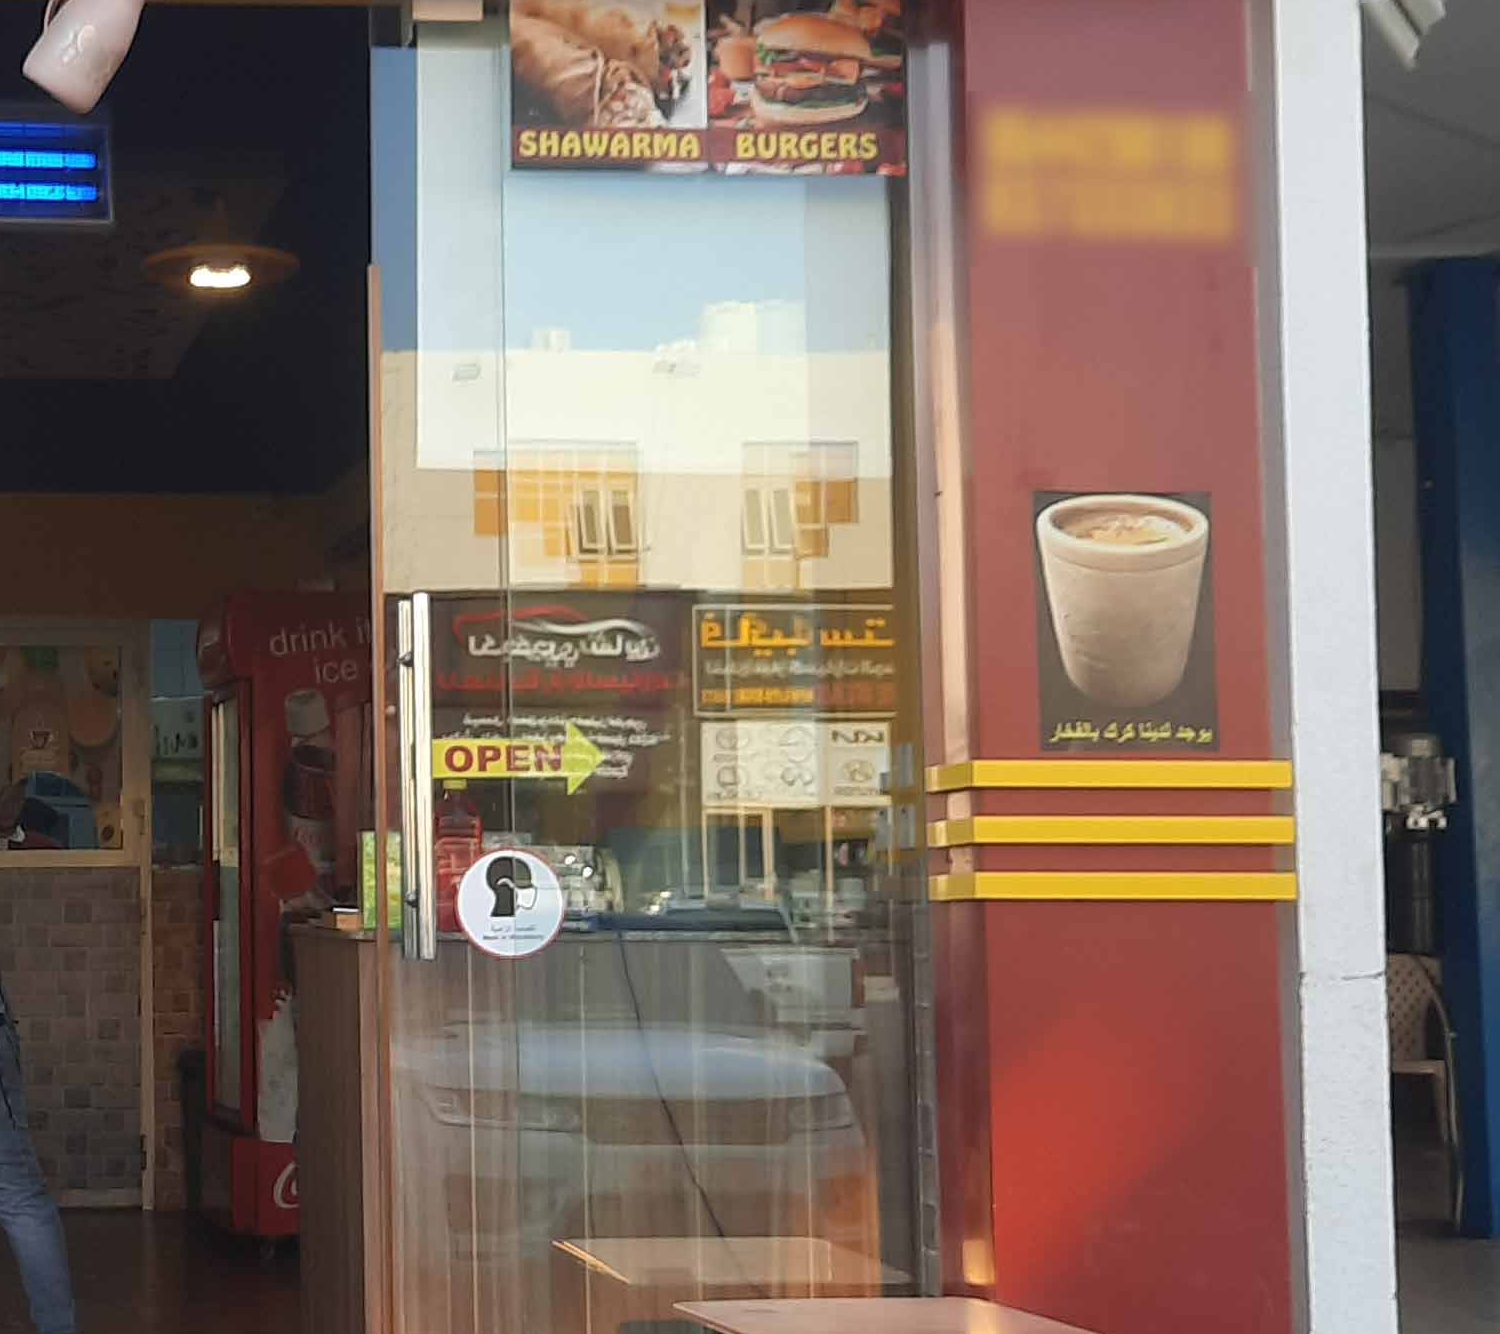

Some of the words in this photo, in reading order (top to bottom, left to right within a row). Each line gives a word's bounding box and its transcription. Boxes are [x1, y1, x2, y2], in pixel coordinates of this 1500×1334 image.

[518, 130, 700, 159] SHAWARMA
[735, 131, 879, 161] BURGERS
[269, 619, 347, 657] drink
[312, 657, 358, 684] ice
[444, 744, 563, 773] OPEN
